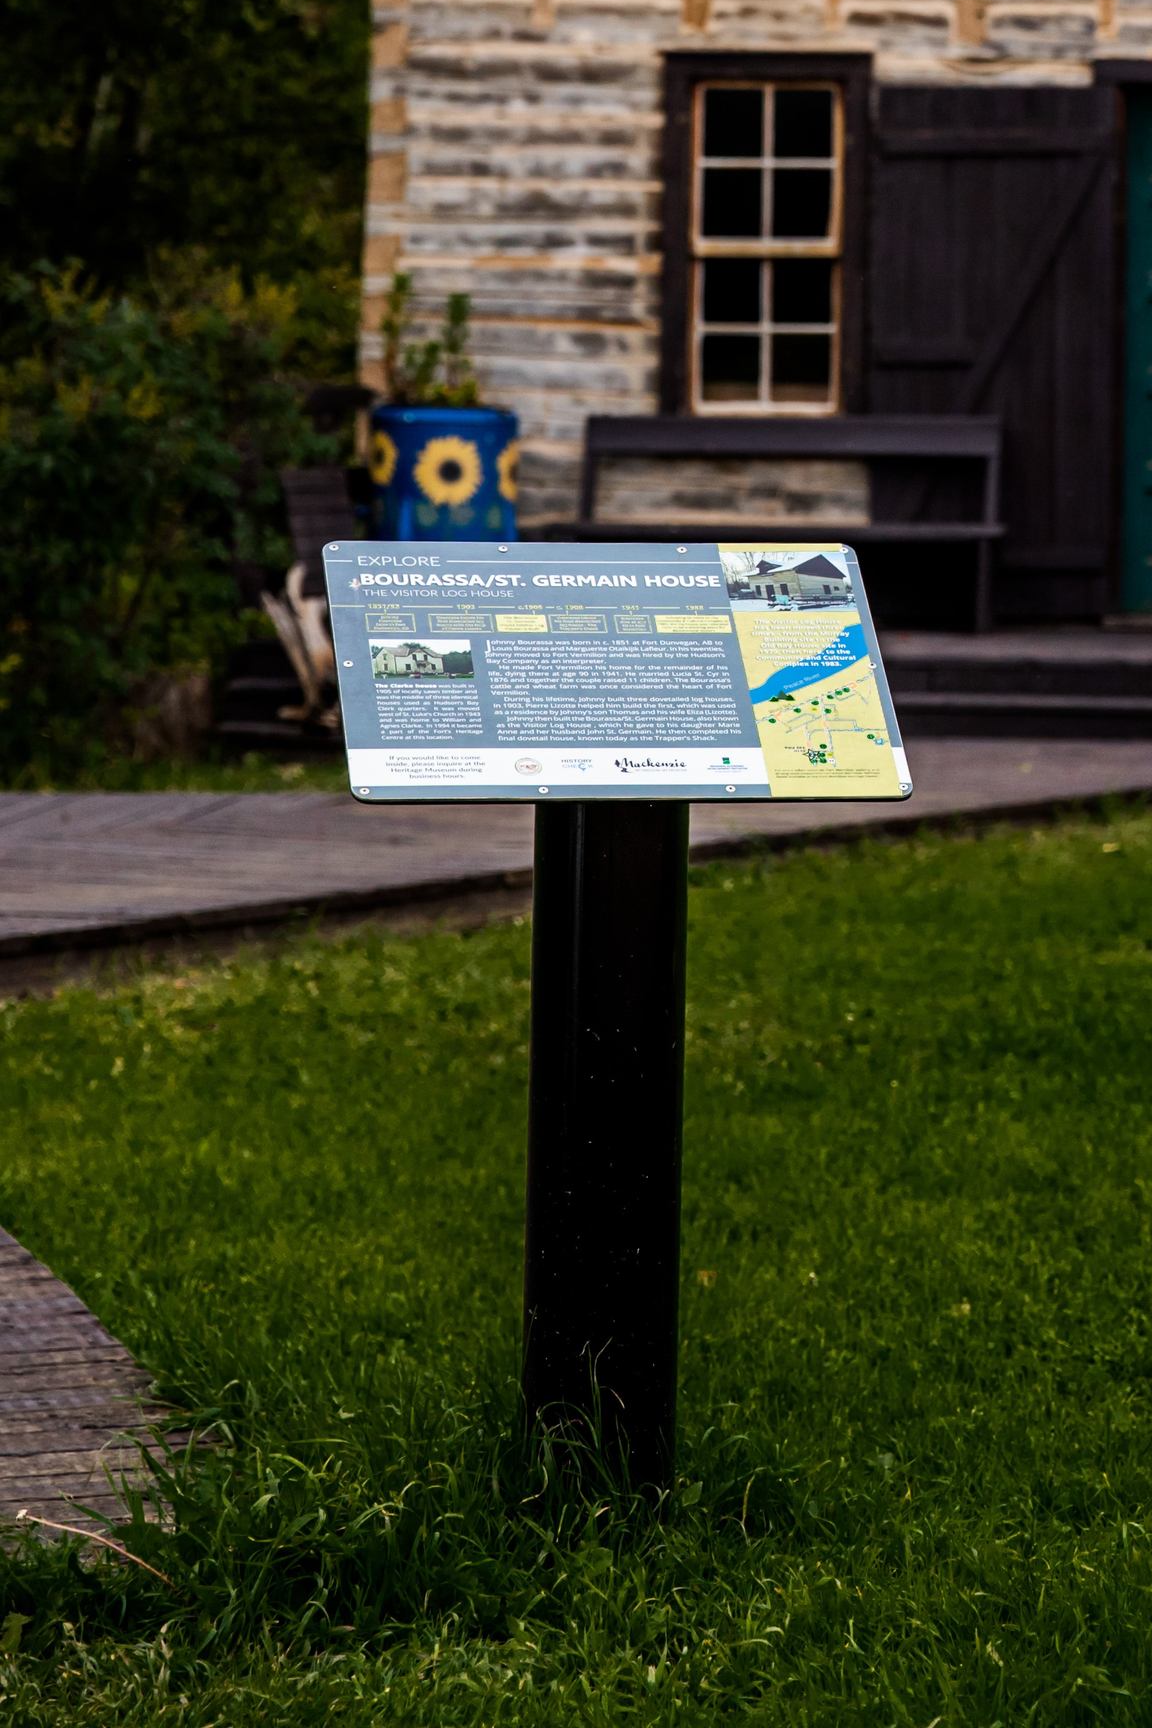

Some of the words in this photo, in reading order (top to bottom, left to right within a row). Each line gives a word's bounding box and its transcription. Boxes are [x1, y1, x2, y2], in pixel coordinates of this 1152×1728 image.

[357, 556, 440, 567] EXPLORE
[360, 573, 526, 588] BOURASSA/ST.
[532, 574, 637, 588] GERMAIN
[644, 575, 720, 588] HOUSE
[365, 589, 387, 598] THE
[390, 589, 438, 598] VISITOR
[441, 589, 467, 598] LOG
[470, 589, 513, 598] HOUSE
[621, 758, 687, 768] Mackenzie
